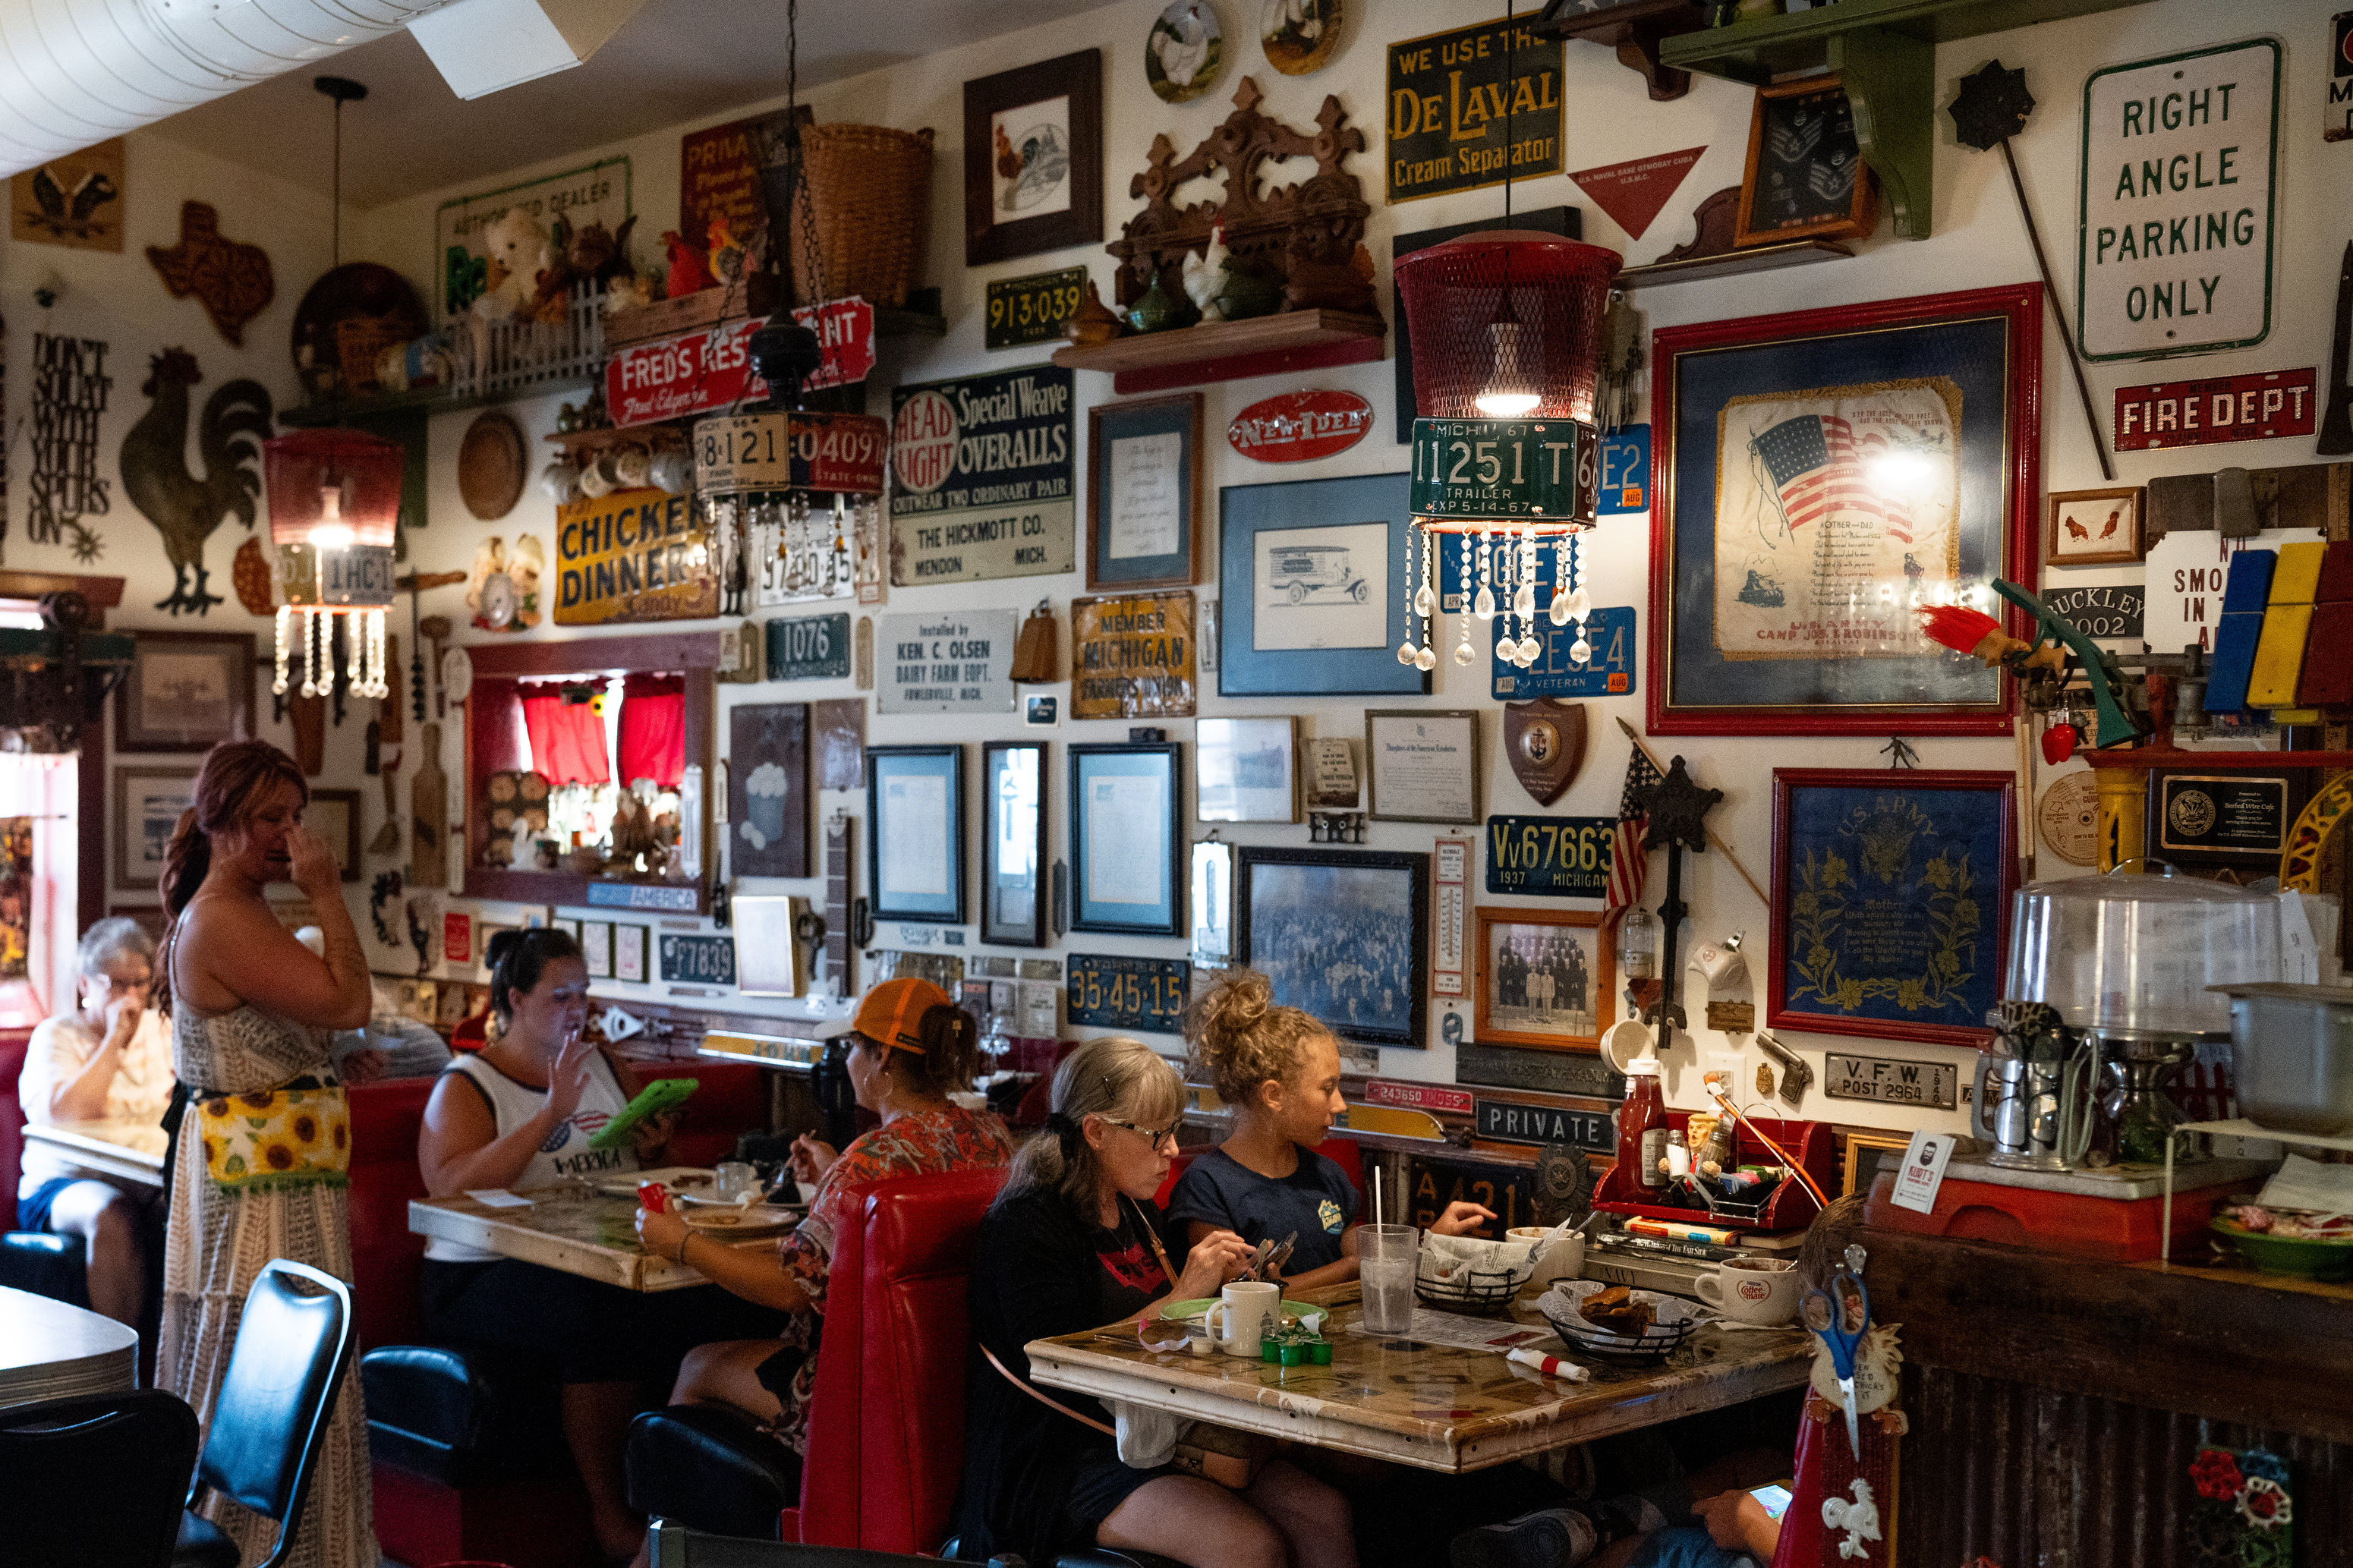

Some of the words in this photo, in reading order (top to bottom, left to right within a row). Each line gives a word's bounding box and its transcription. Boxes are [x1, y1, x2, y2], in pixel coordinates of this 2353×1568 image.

[1399, 48, 1432, 75] WE
[1443, 35, 1490, 65] USE
[2123, 83, 2237, 138] RIGHT
[1394, 156, 1451, 187] Cream
[1593, 172, 1615, 181] NAVAL
[1617, 166, 1636, 175] BASE
[1674, 156, 1693, 165] CUBA
[2115, 146, 2239, 200] ANGLE
[2097, 208, 2254, 265] PARKING
[2126, 276, 2221, 323] ONLY
[958, 380, 1017, 430] Special
[1017, 376, 1068, 419] Weave
[2123, 397, 2200, 435] FIRE
[2212, 386, 2309, 427] DEPT
[896, 396, 952, 444] HEAD
[1507, 426, 1527, 436] 67
[957, 423, 1067, 474] OVERALLS
[898, 442, 954, 488] LIGHT
[893, 493, 943, 514] OUTWEAR
[947, 489, 969, 508] TWO
[972, 481, 1032, 505] ORDINARY
[1037, 477, 1067, 497] PAIR
[1446, 486, 1511, 499] TRAILER
[1626, 493, 1640, 502] AUG
[1432, 502, 1457, 512] EXP
[1462, 502, 1530, 512] 5-14-67
[918, 527, 942, 549] THE
[946, 518, 1017, 546] HICKMOTT
[1022, 514, 1046, 537] CO.
[915, 557, 962, 577] MENDON
[1015, 546, 1047, 565] MICH.
[1448, 596, 1460, 607] APR
[2184, 597, 2204, 622] IN
[919, 624, 956, 637] Installed
[959, 624, 969, 638] by
[1101, 612, 1165, 633] MEMBER
[1825, 619, 1885, 628] ARMY
[786, 621, 830, 663] 1076
[1757, 630, 1797, 641] CAMP
[950, 641, 991, 659] OLSEN
[1084, 637, 1184, 670] MICHIGAN
[931, 664, 959, 683] FARM
[1501, 679, 1514, 691] AUG
[1536, 678, 1586, 689] VETERAN
[1611, 678, 1626, 688] AUG
[1501, 871, 1525, 885] 1937
[1843, 1079, 1879, 1095] POST
[1885, 1083, 1922, 1100] 2964
[1490, 1108, 1599, 1144] PRIVATE
[1672, 1244, 1683, 1253] THE
[1605, 1266, 1636, 1284] NAVY
[1741, 1286, 1763, 1296] Coffee
